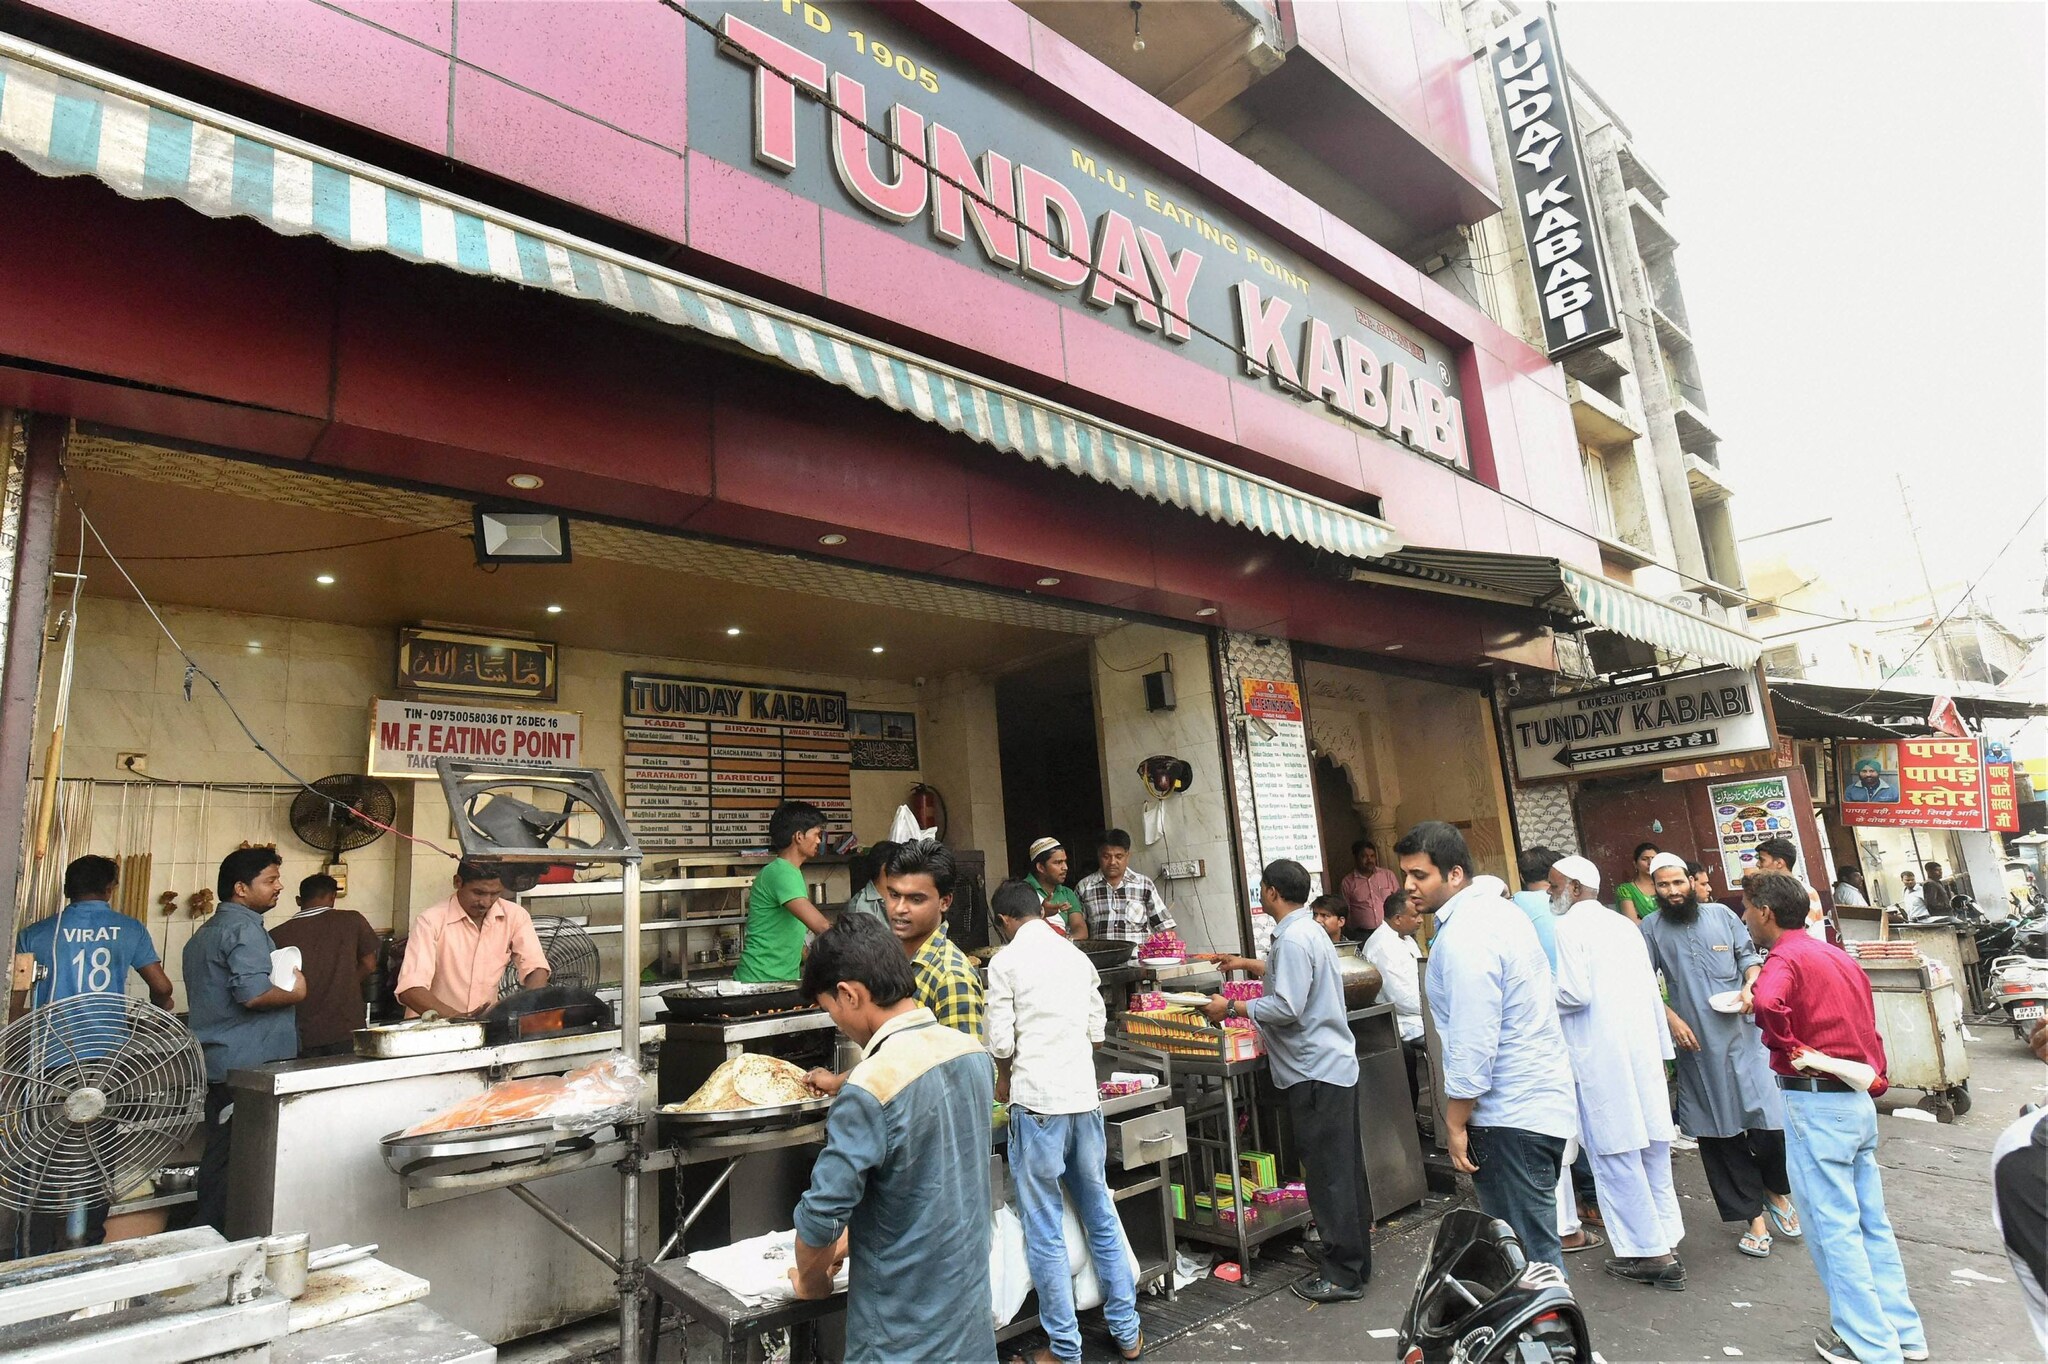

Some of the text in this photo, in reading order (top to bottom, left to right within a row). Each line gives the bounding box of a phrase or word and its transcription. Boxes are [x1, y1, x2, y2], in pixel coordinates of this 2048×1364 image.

[848, 30, 940, 94] 1905
[1496, 15, 1593, 340] TUNDAY KABABI
[1071, 148, 1311, 295] M.U. EATING POINT
[719, 12, 1470, 471] TUNDAY KABABI
[632, 680, 847, 725] TUNDAY KABABI
[1580, 686, 1664, 711] M.U. EATING POINT
[500, 715, 513, 725] DT
[548, 718, 558, 728] 16
[644, 719, 686, 729] KABAB
[1516, 684, 1754, 748] TUNDAY KABABI
[724, 724, 767, 733] BIRYANI
[813, 730, 845, 738] DELICACIES
[381, 722, 575, 759] M.F. EATING POINT
[1571, 746, 1616, 762] रास्ता
[1621, 740, 1661, 756] इधर
[1664, 736, 1682, 750] से
[642, 758, 668, 766] Raita
[1905, 742, 1978, 764] पप्पू
[636, 771, 697, 780] PARATHA/ROTI
[717, 774, 775, 782] BARBEQUE
[1903, 766, 1979, 787] पापड़
[1989, 766, 2010, 781] पापड़
[630, 783, 648, 791] Special
[668, 784, 687, 792] Paratha
[1905, 786, 1979, 807] स्टोर
[1990, 781, 2011, 796] वाले
[1995, 814, 2012, 827] जी
[63, 927, 121, 943] VIRAT
[72, 947, 111, 993] 18
